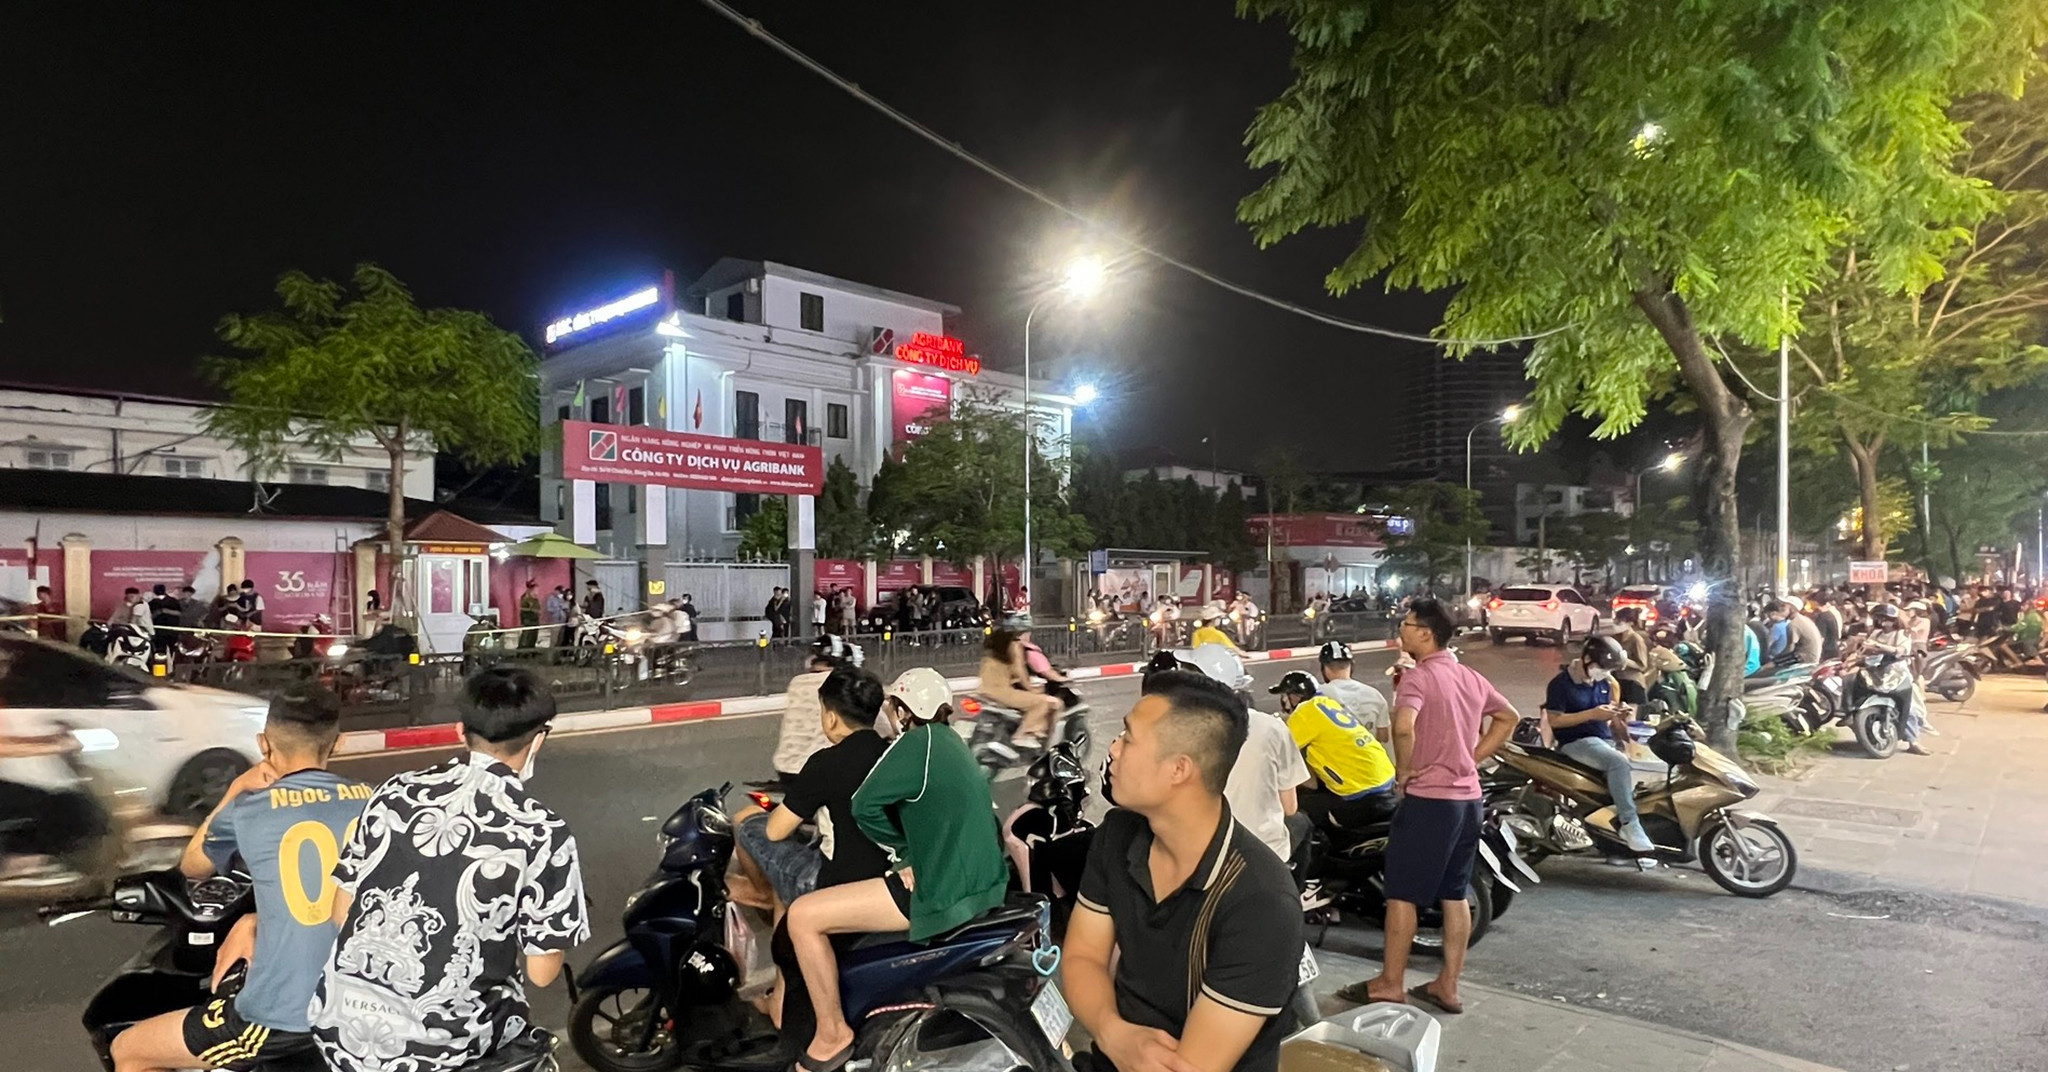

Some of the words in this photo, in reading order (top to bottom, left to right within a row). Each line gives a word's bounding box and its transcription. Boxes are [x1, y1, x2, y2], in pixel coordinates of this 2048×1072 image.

[913, 333, 963, 354] AGRIBANK
[895, 344, 924, 362] CÔNG
[925, 351, 939, 364] TY
[940, 355, 963, 370] DỊCH
[964, 358, 978, 375] VỤ
[622, 446, 664, 464] CÔNG
[666, 453, 684, 467] TY
[687, 455, 719, 471] DỊCH
[721, 457, 740, 474] VỤ
[743, 460, 805, 477] AGRIBANK
